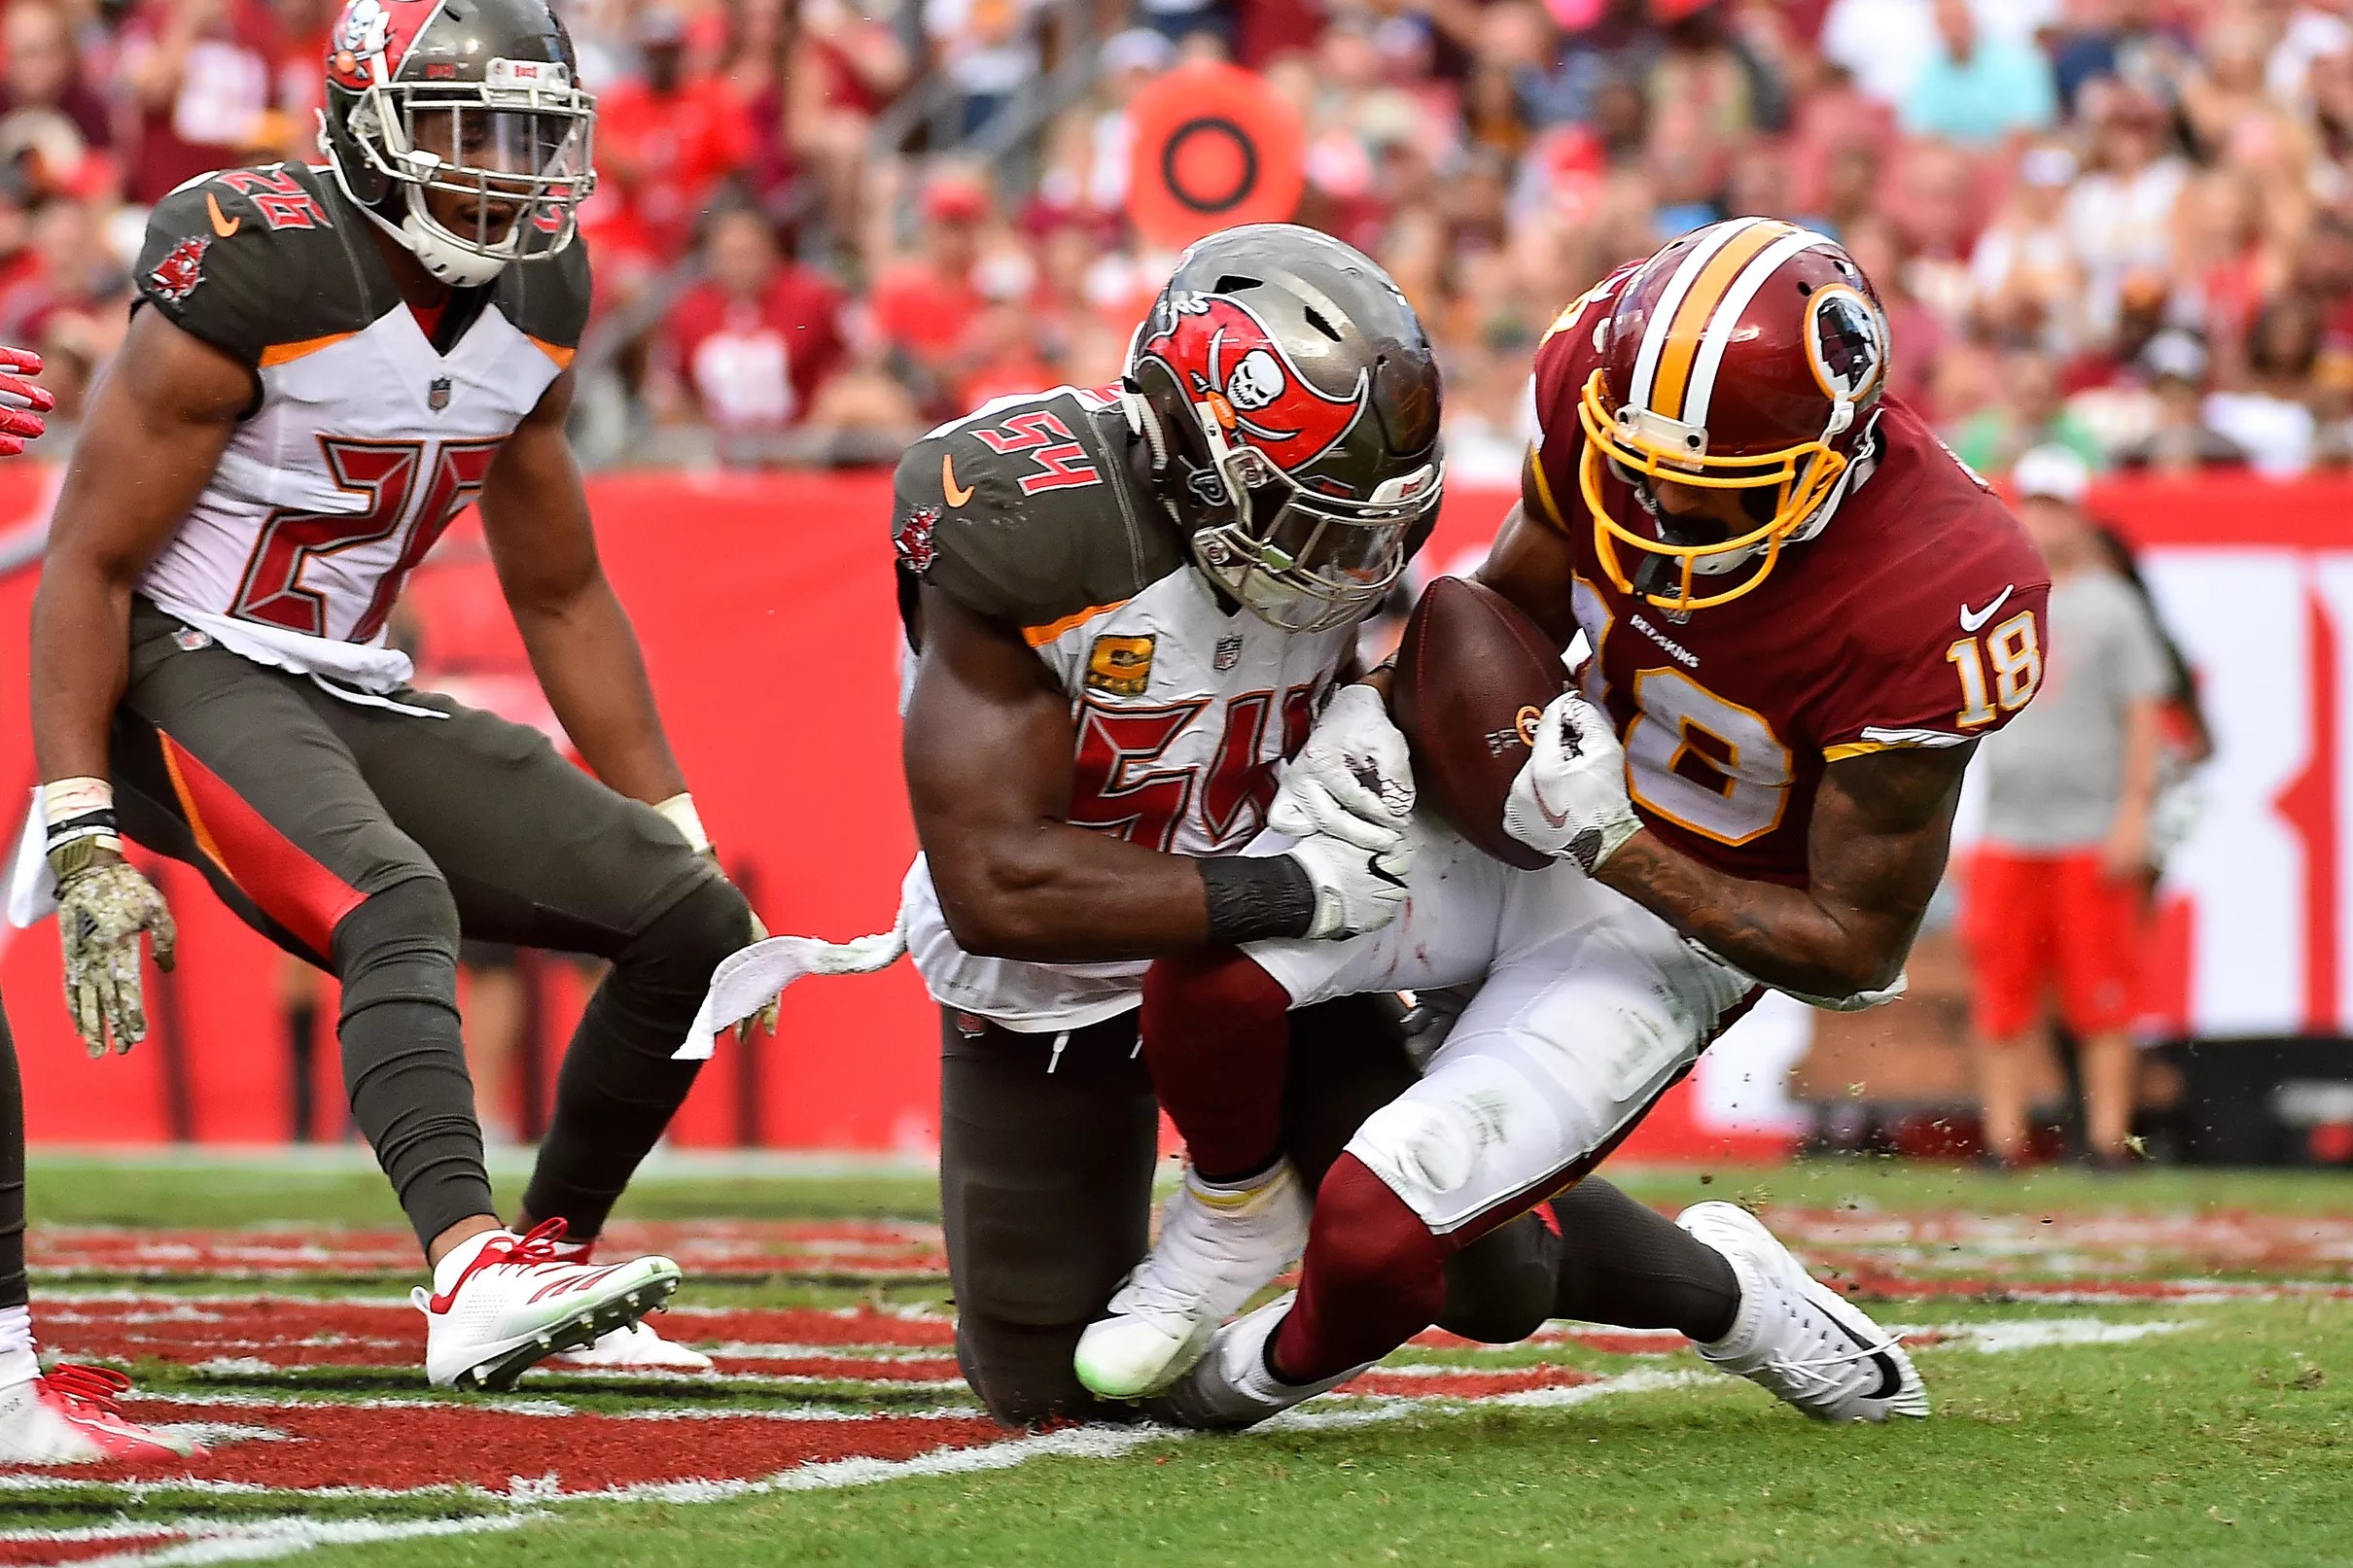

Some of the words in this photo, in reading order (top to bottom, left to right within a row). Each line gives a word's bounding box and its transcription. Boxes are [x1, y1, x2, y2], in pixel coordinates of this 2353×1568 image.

[215, 170, 334, 231] 26
[967, 410, 1104, 498] 54
[1946, 610, 2042, 728] 18
[1068, 679, 1315, 854] 54
